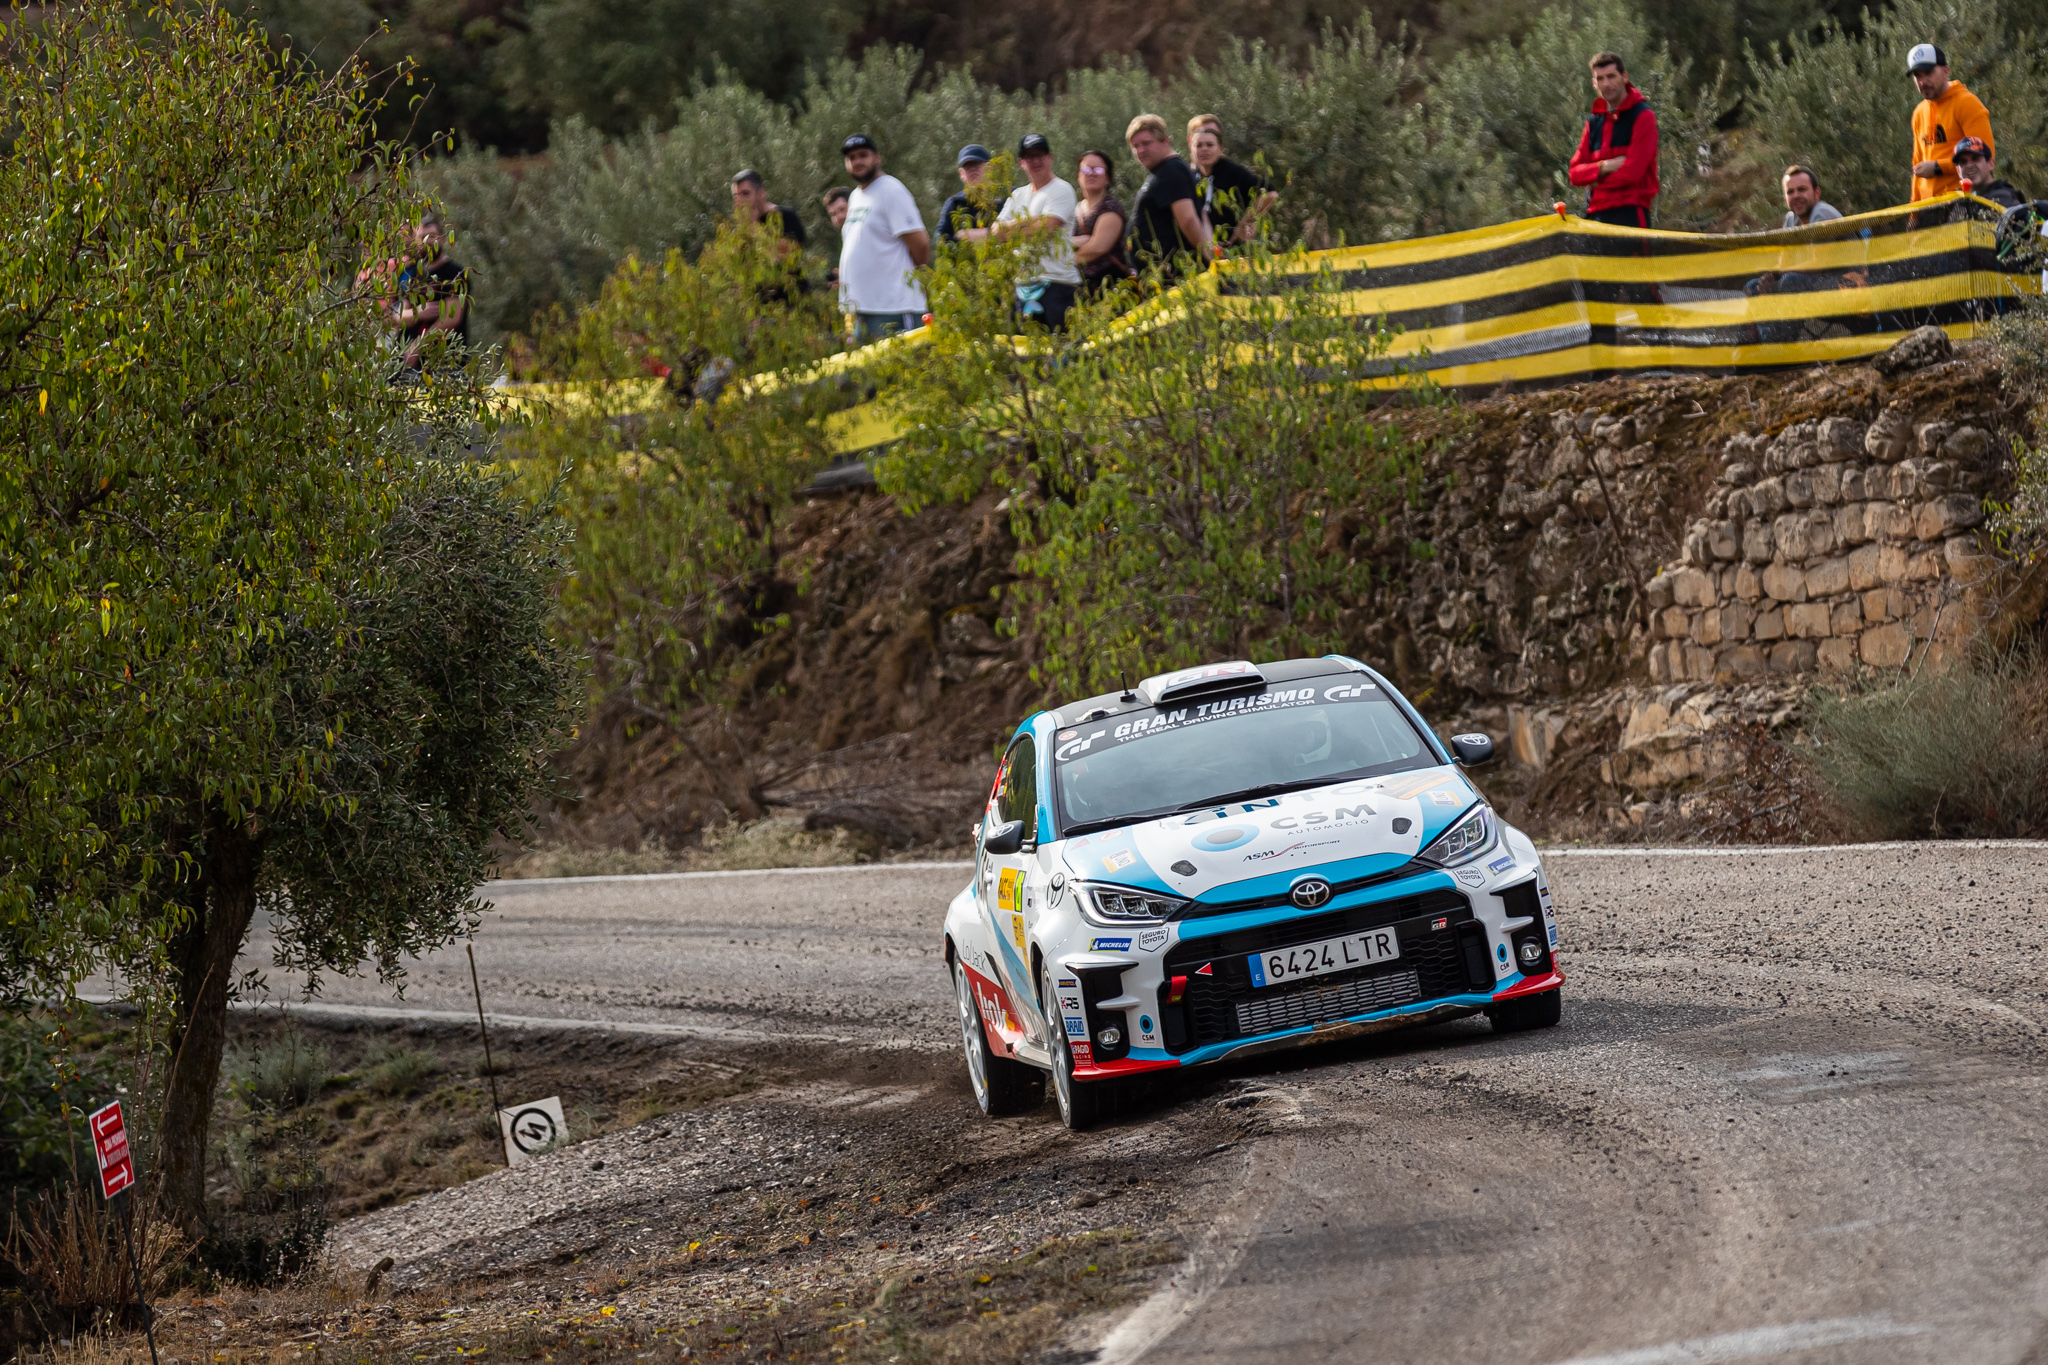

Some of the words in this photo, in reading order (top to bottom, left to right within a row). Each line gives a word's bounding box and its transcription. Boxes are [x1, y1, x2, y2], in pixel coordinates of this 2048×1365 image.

[1114, 708, 1187, 738] GRAN
[1197, 688, 1315, 717] TURISMO
[1117, 731, 1144, 743] THE
[1146, 723, 1180, 736] REAL
[1183, 710, 1237, 725] DRIVING
[1239, 699, 1316, 715] SIMULATOR
[1270, 804, 1378, 829] CSM
[1243, 850, 1275, 862] ASM
[1141, 929, 1166, 940] SEGURO
[1142, 935, 1165, 945] TOYOTA
[1268, 944, 1335, 979] 6424
[1342, 933, 1392, 965] LTR
[1255, 973, 1262, 981] E
[1066, 1020, 1085, 1033] BRAID
